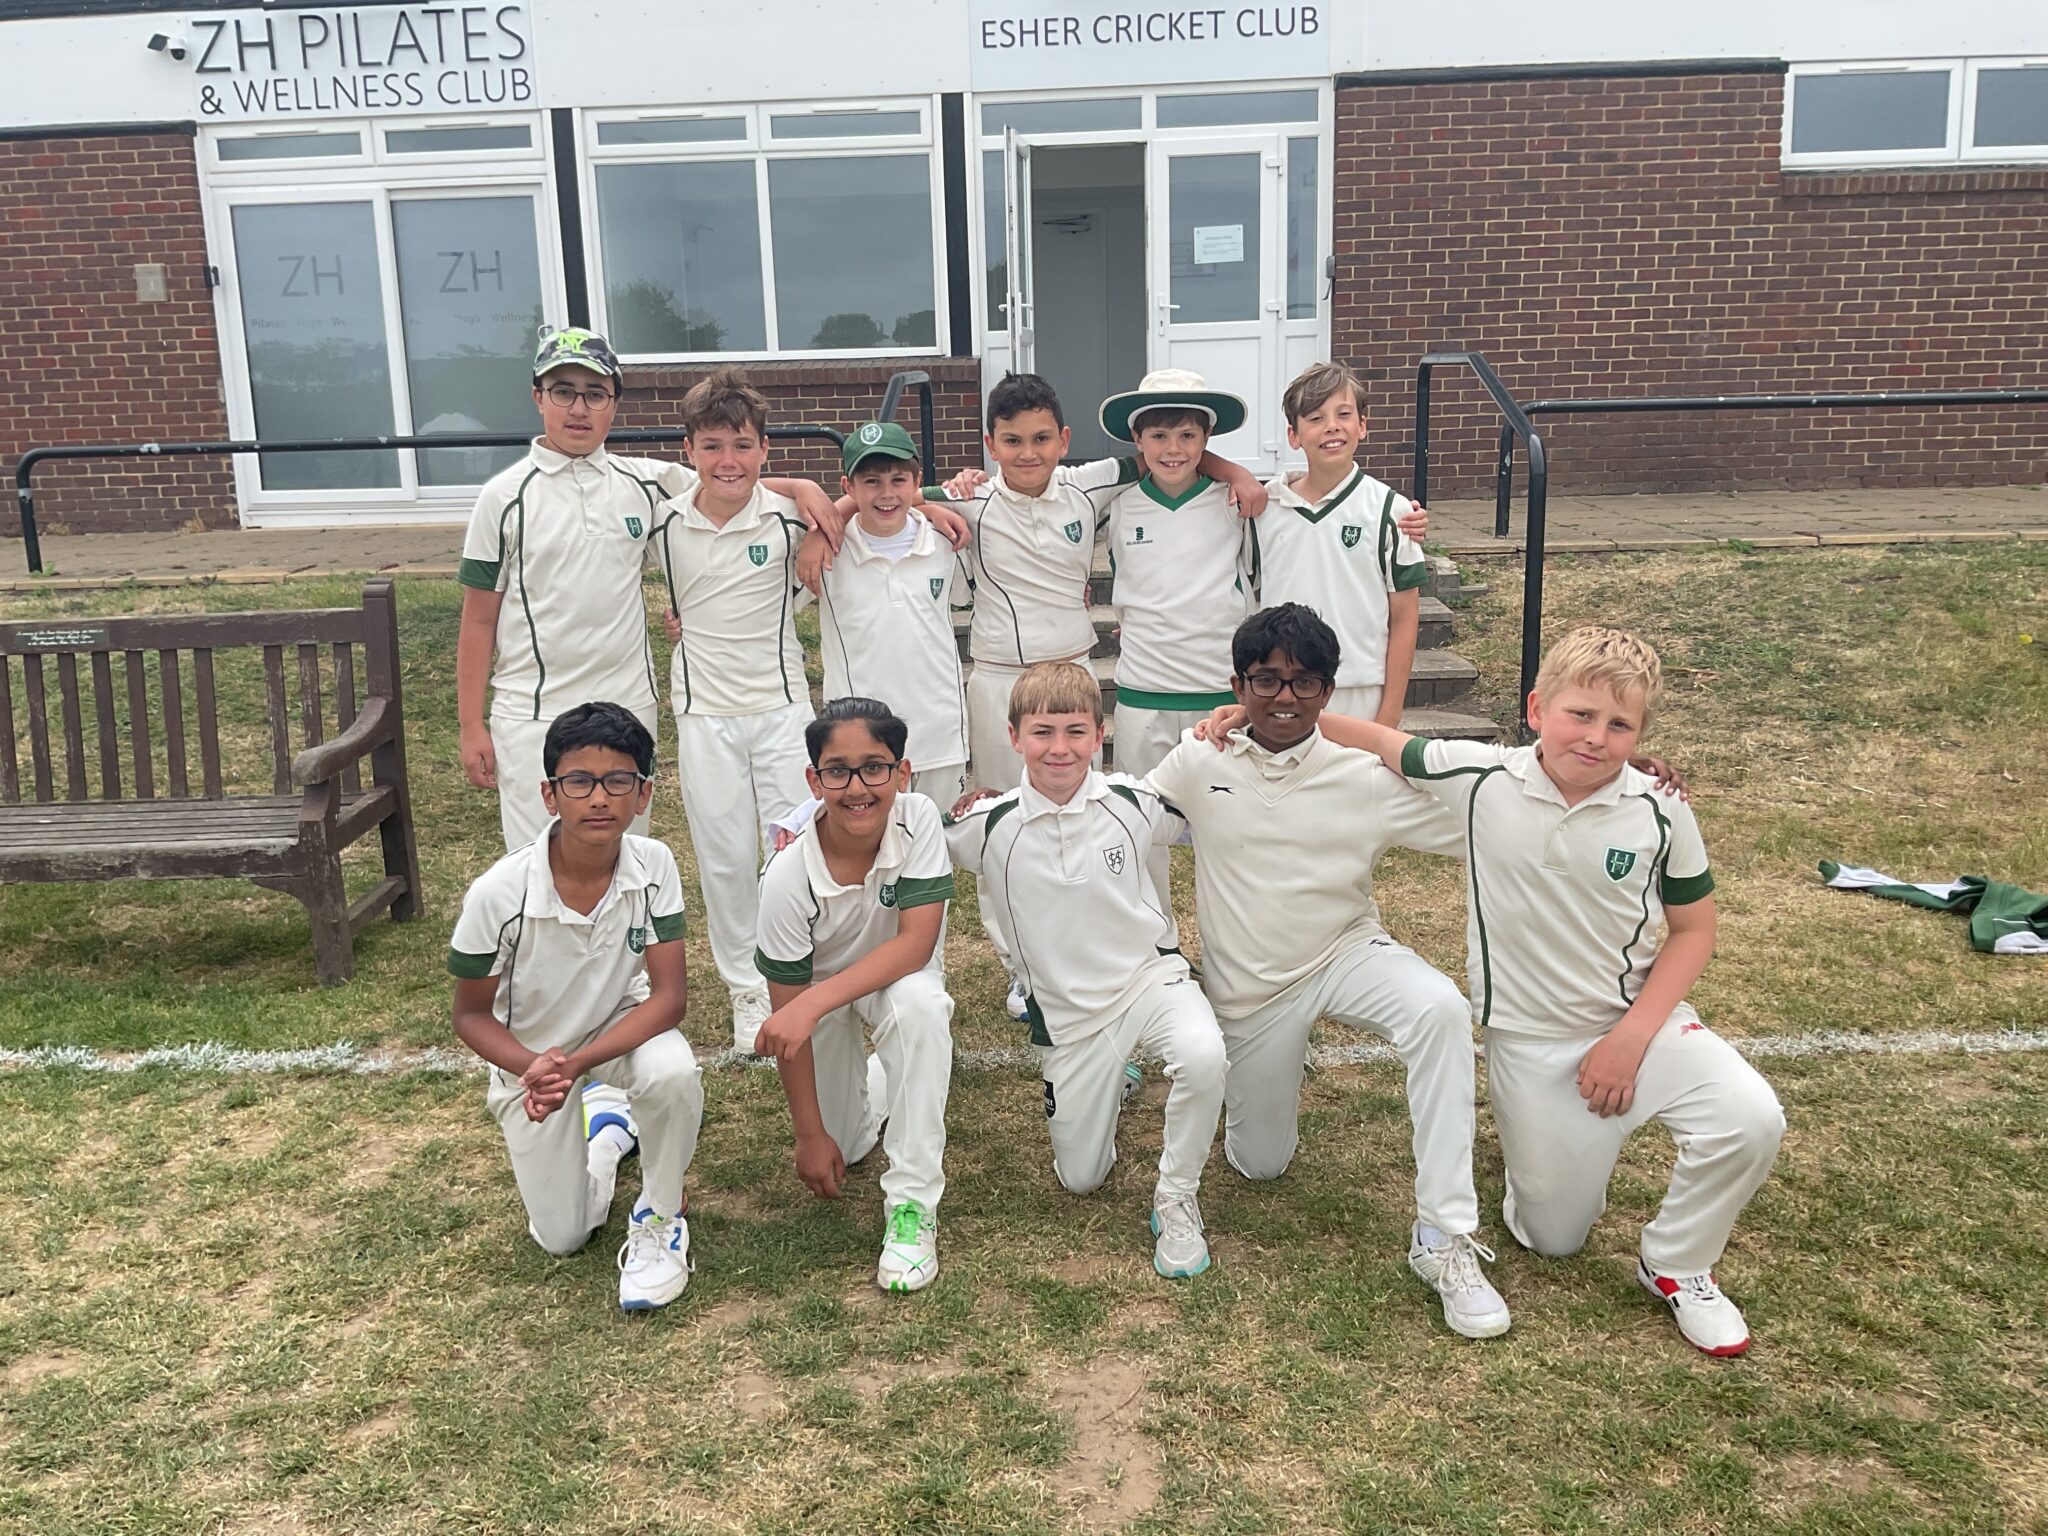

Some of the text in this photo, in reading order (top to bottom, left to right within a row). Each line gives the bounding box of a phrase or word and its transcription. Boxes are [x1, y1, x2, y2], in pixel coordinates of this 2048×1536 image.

[192, 6, 525, 73] ZH PILATES
[981, 7, 1320, 48] ESHER CRICKET CLUB
[200, 68, 531, 114] & WELLNESS CLUB
[278, 254, 345, 297] ZH
[437, 250, 504, 293] ZH
[556, 331, 590, 354] NY
